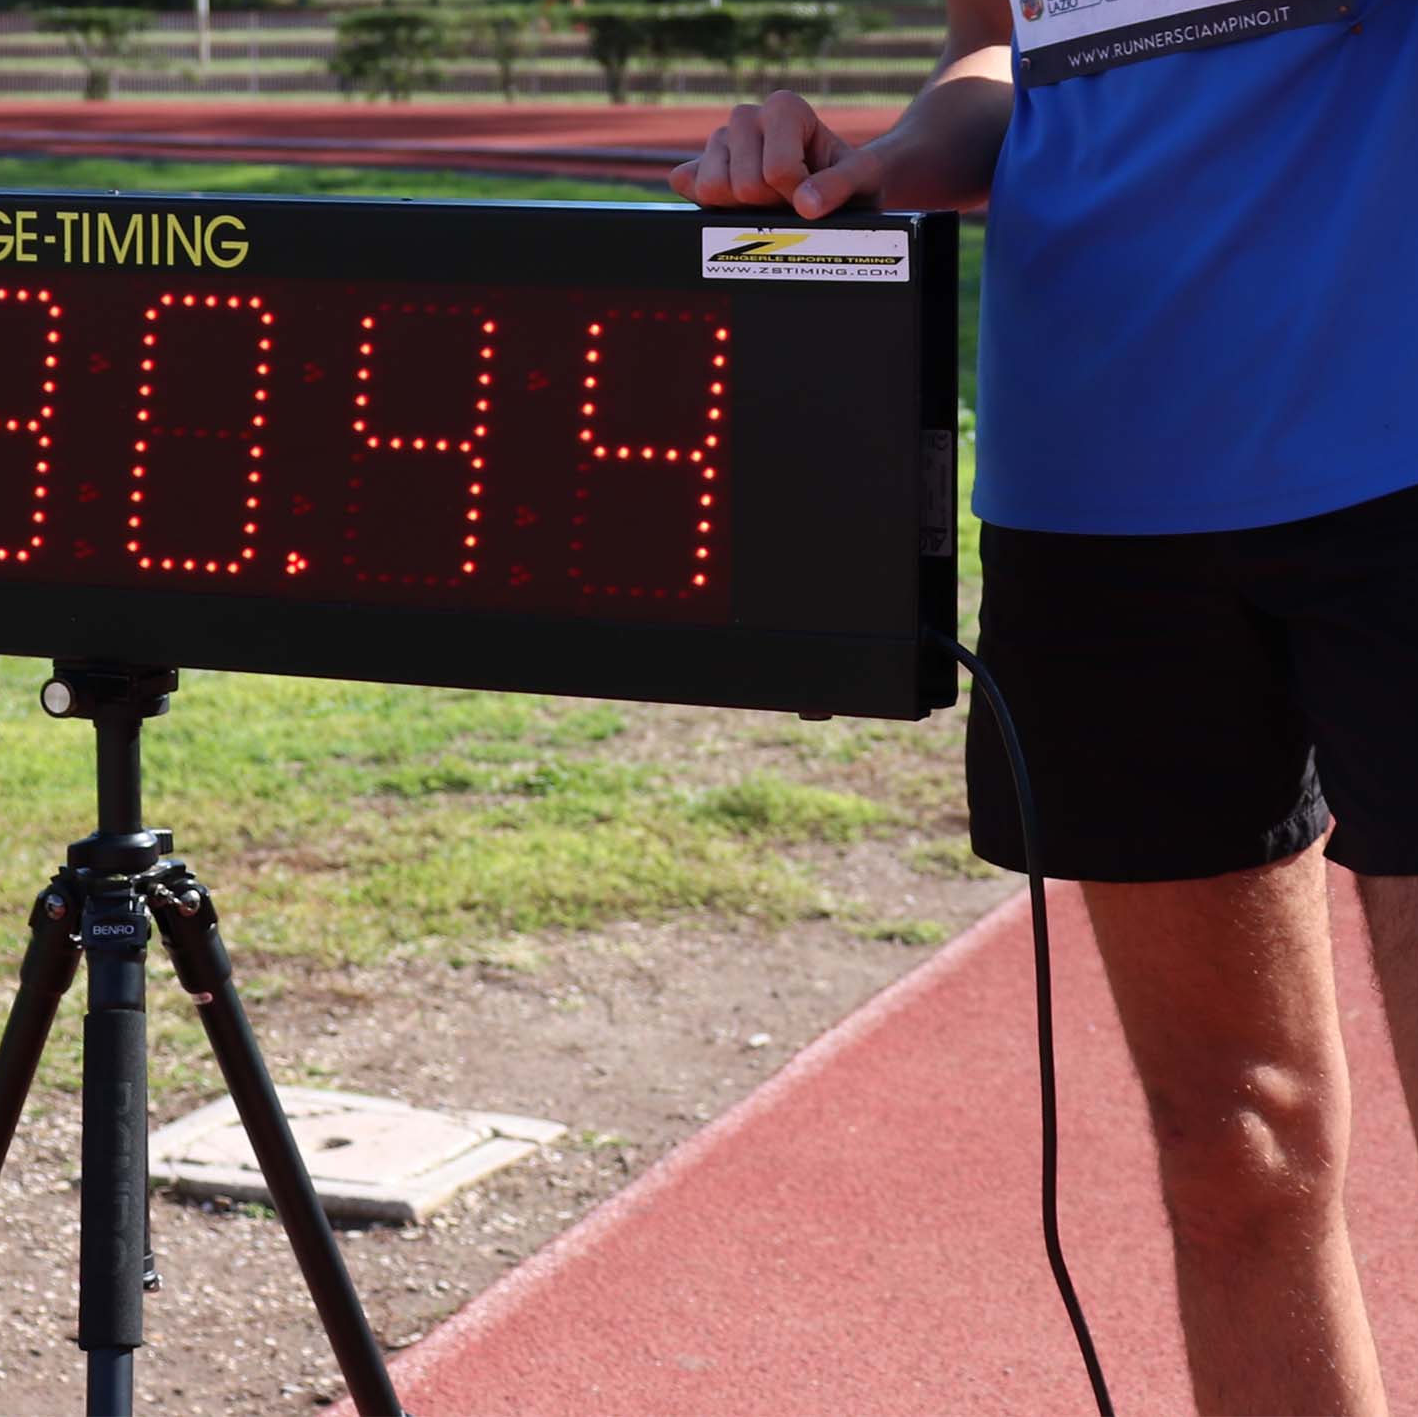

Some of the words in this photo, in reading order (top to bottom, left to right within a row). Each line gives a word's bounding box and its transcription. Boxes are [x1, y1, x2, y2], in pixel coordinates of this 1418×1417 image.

[1067, 6, 1291, 68] WWW.RUNNERSCIAMPINO.IT
[717, 254, 784, 262] ZINGERLE
[788, 255, 842, 263] SPORTS
[847, 256, 896, 264] TIMING
[706, 266, 898, 277] WWW.ZSTIMING.COM
[92, 924, 135, 936] BENRO
